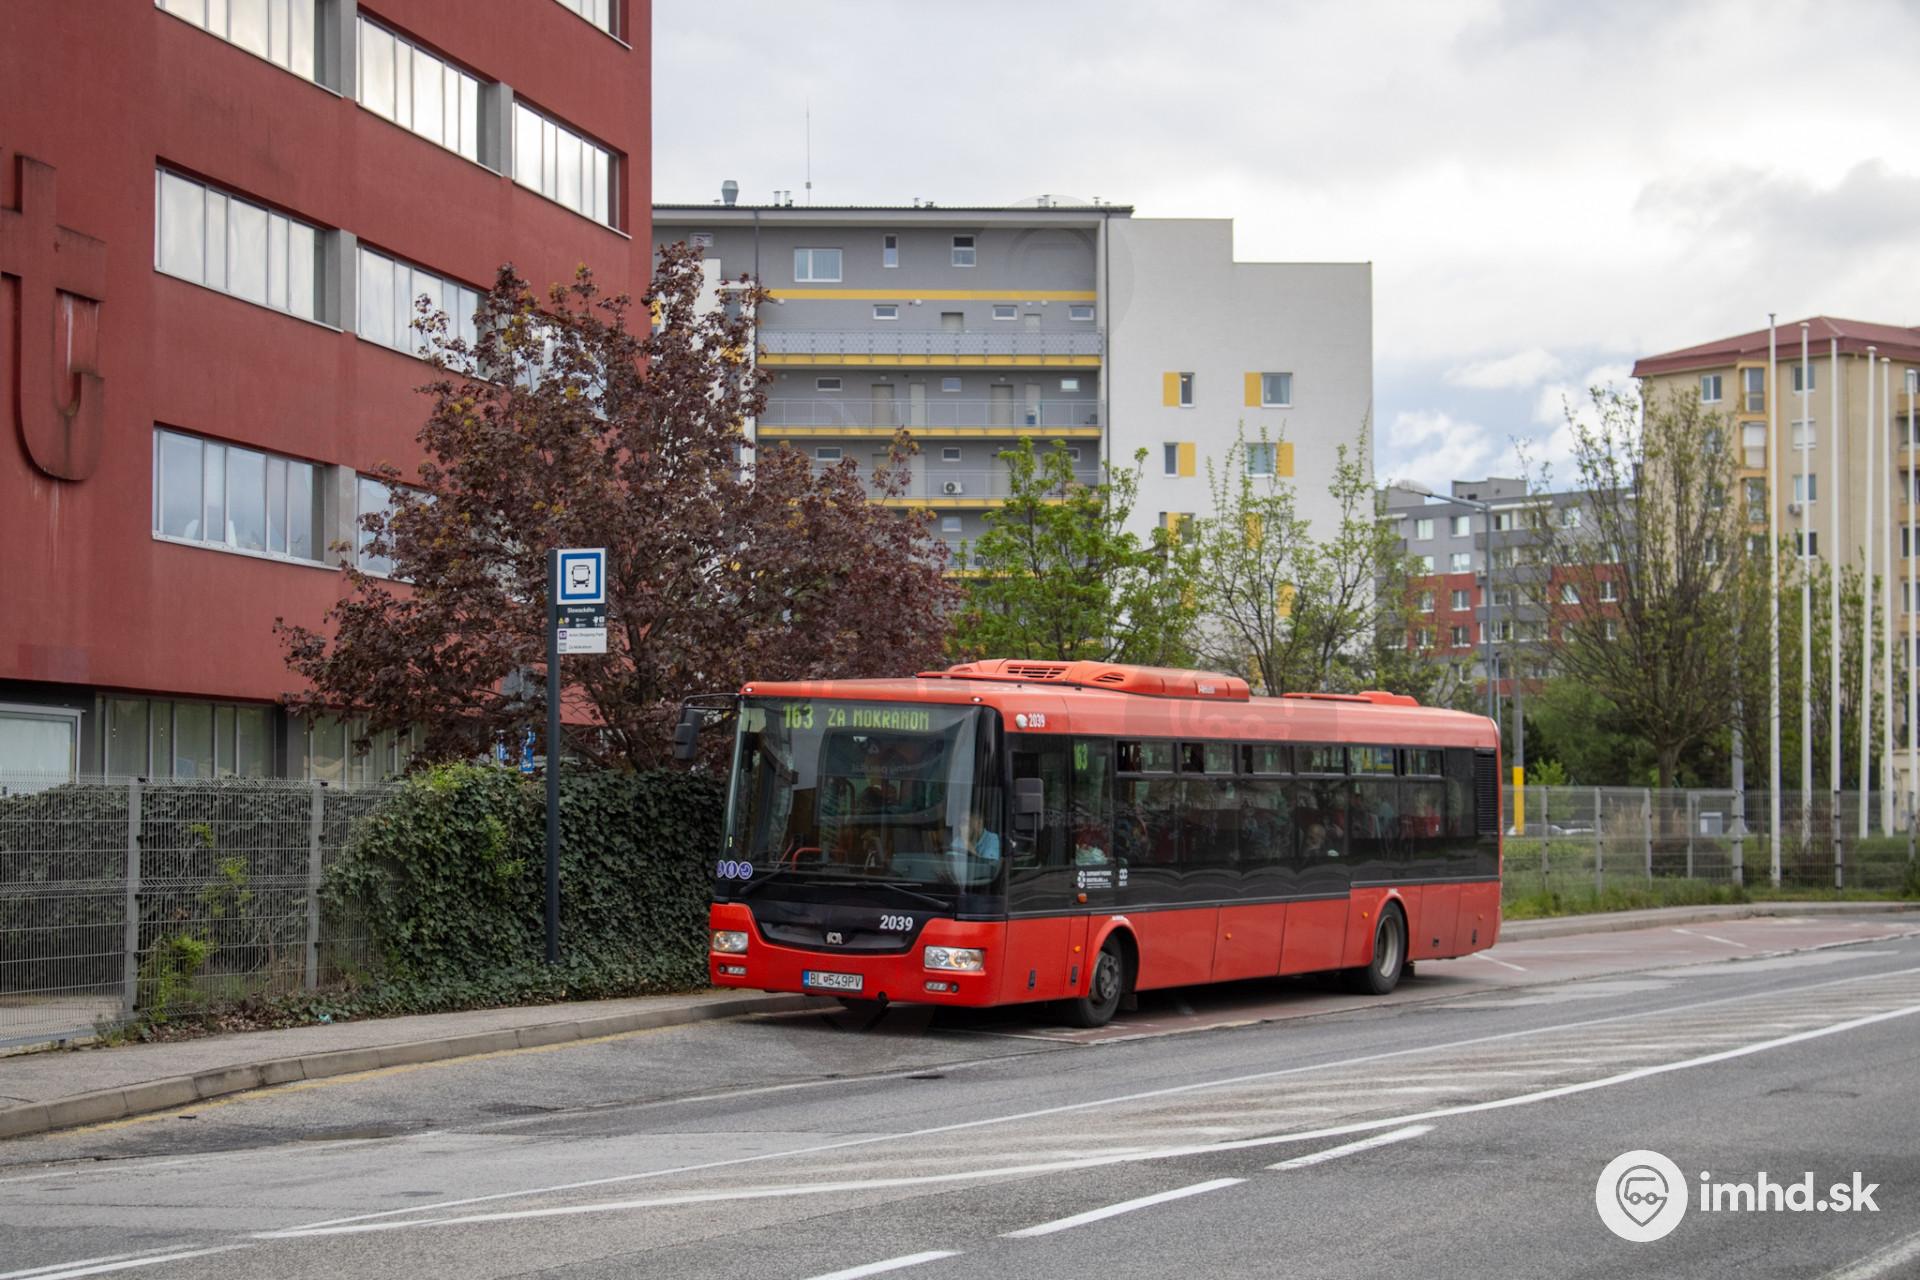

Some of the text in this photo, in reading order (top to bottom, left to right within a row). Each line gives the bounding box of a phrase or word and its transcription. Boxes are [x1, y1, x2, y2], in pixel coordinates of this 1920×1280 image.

[783, 703, 814, 729] 163
[828, 708, 846, 727] ZA
[1028, 712, 1046, 728] 2039
[879, 914, 914, 931] 2039
